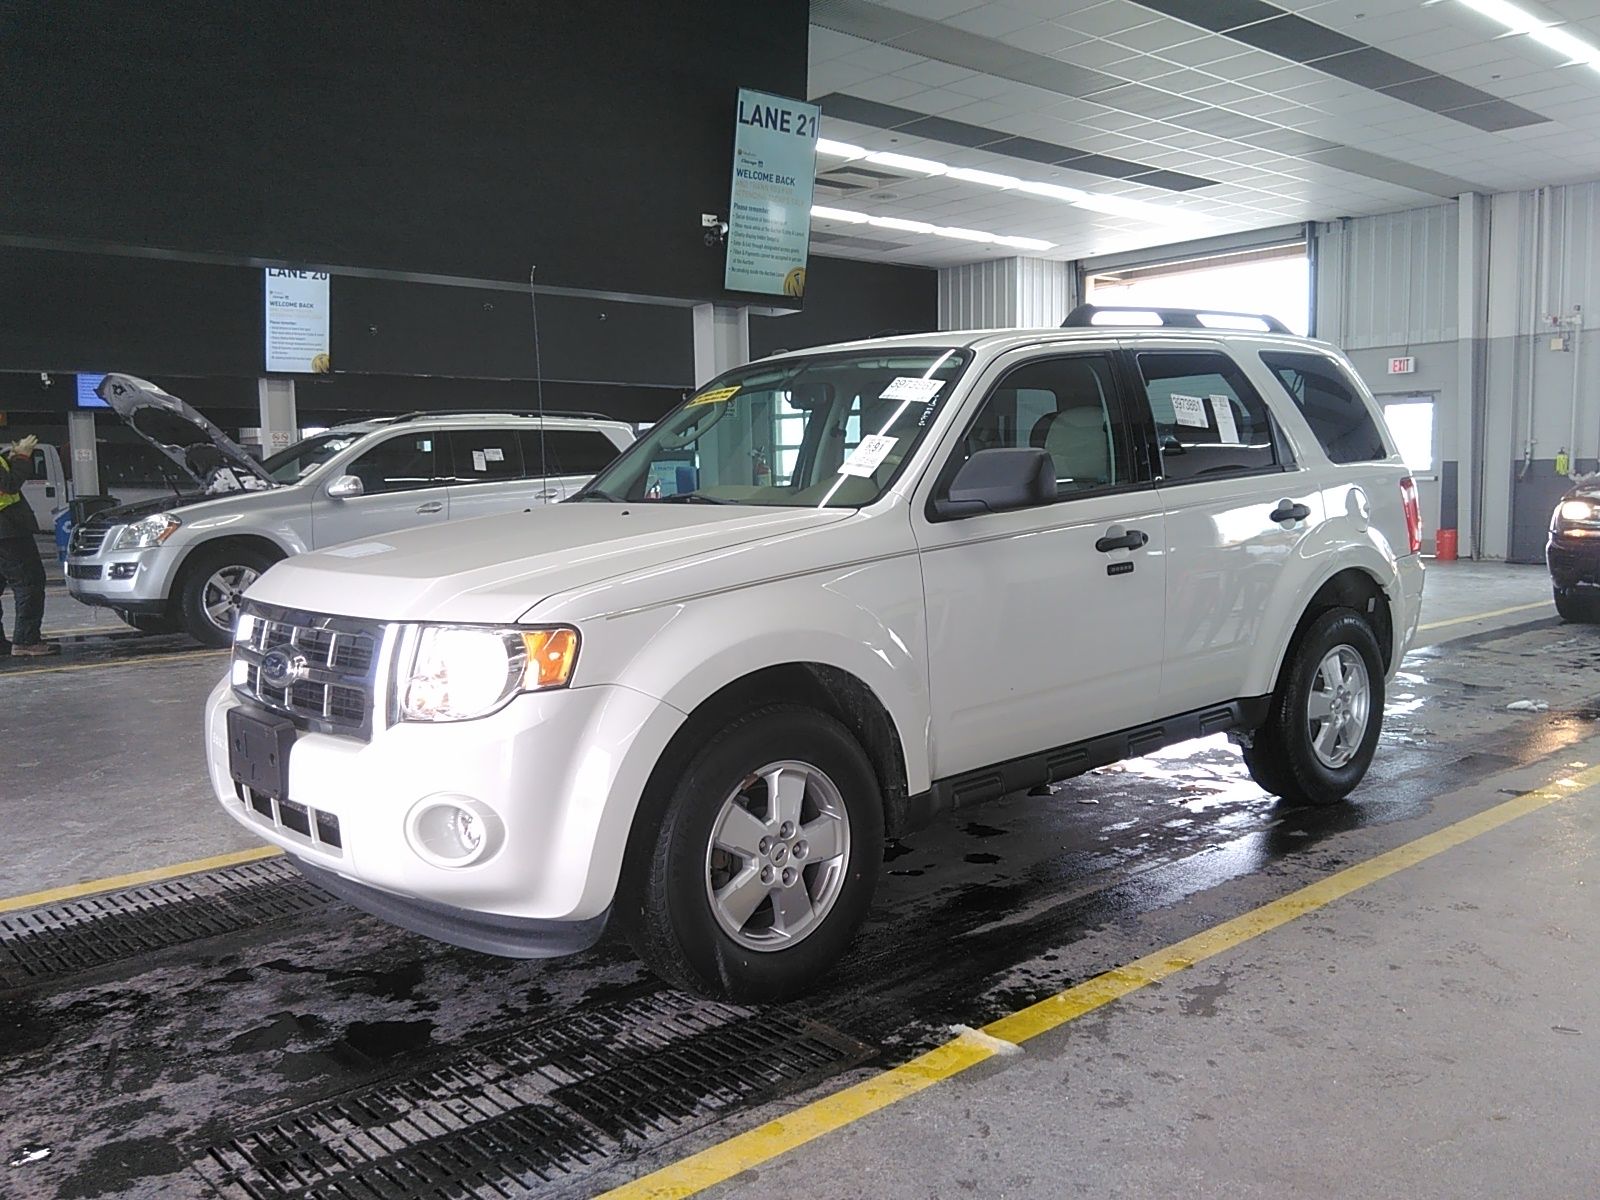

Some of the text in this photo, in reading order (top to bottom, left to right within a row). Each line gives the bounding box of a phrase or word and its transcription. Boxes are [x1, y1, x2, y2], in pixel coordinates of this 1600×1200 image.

[738, 101, 816, 138] LANE 21
[736, 167, 796, 186] WELCOME BACK
[1393, 359, 1411, 373] EXIT
